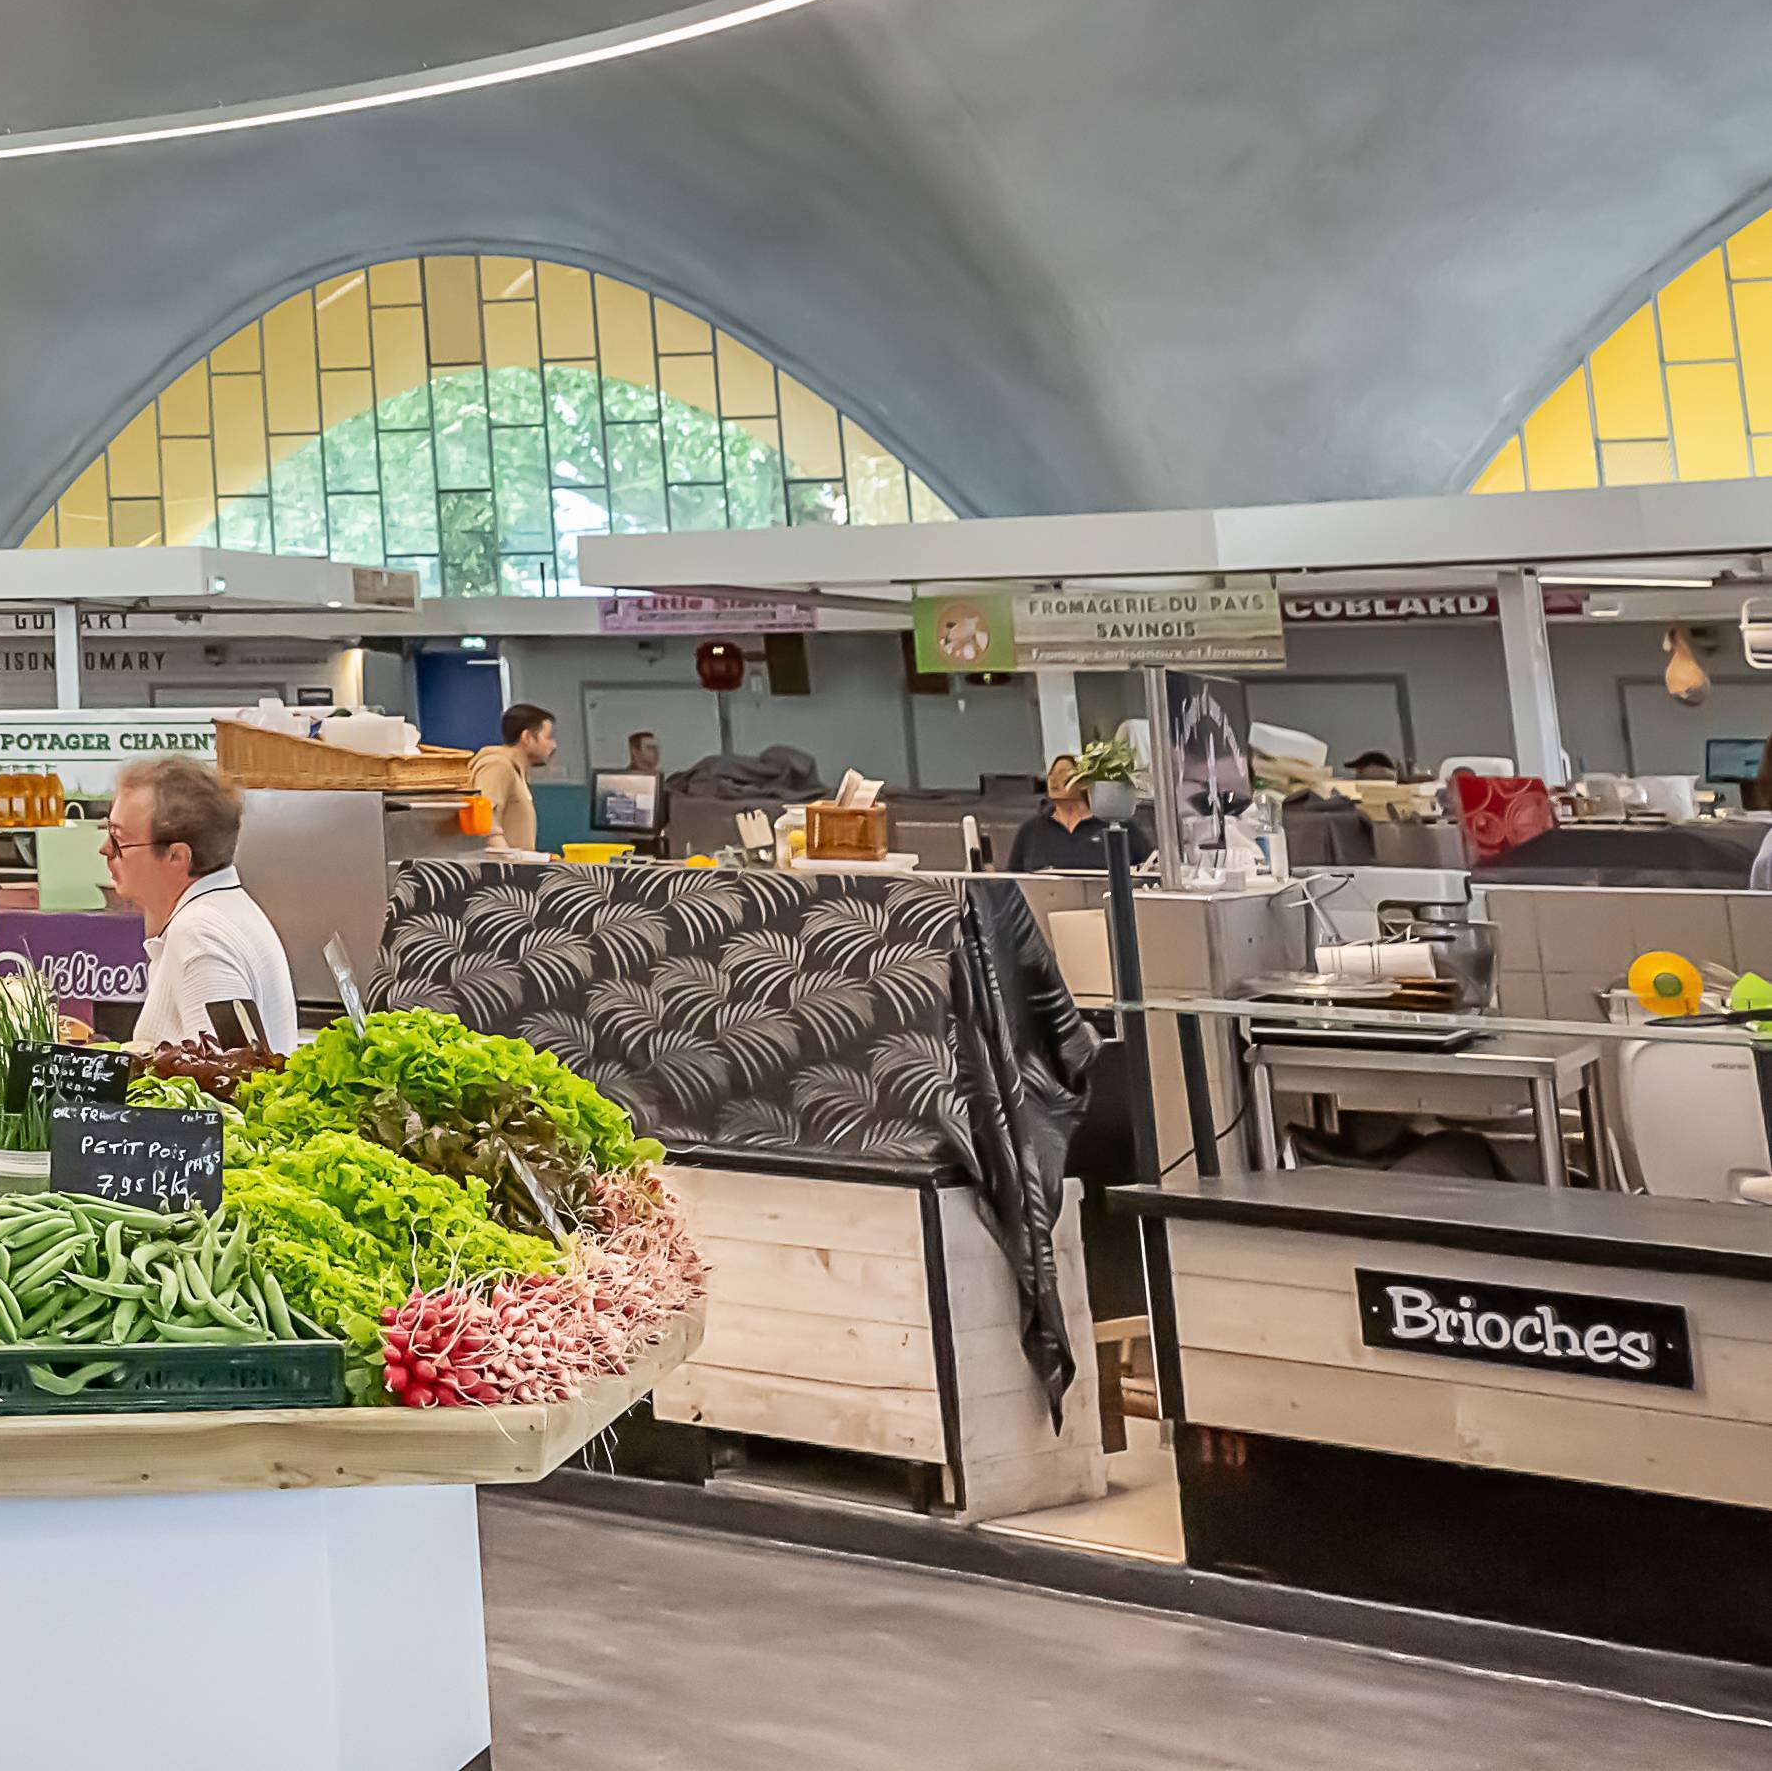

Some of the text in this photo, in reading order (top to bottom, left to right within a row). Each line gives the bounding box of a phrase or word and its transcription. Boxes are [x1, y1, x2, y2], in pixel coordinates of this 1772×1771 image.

[1029, 594, 1264, 615] FROMAGERIE DU PAYS
[1096, 621, 1197, 639] SAVINOIS
[0, 733, 111, 750] POTAGER
[1385, 1285, 1656, 1371] Brioches
